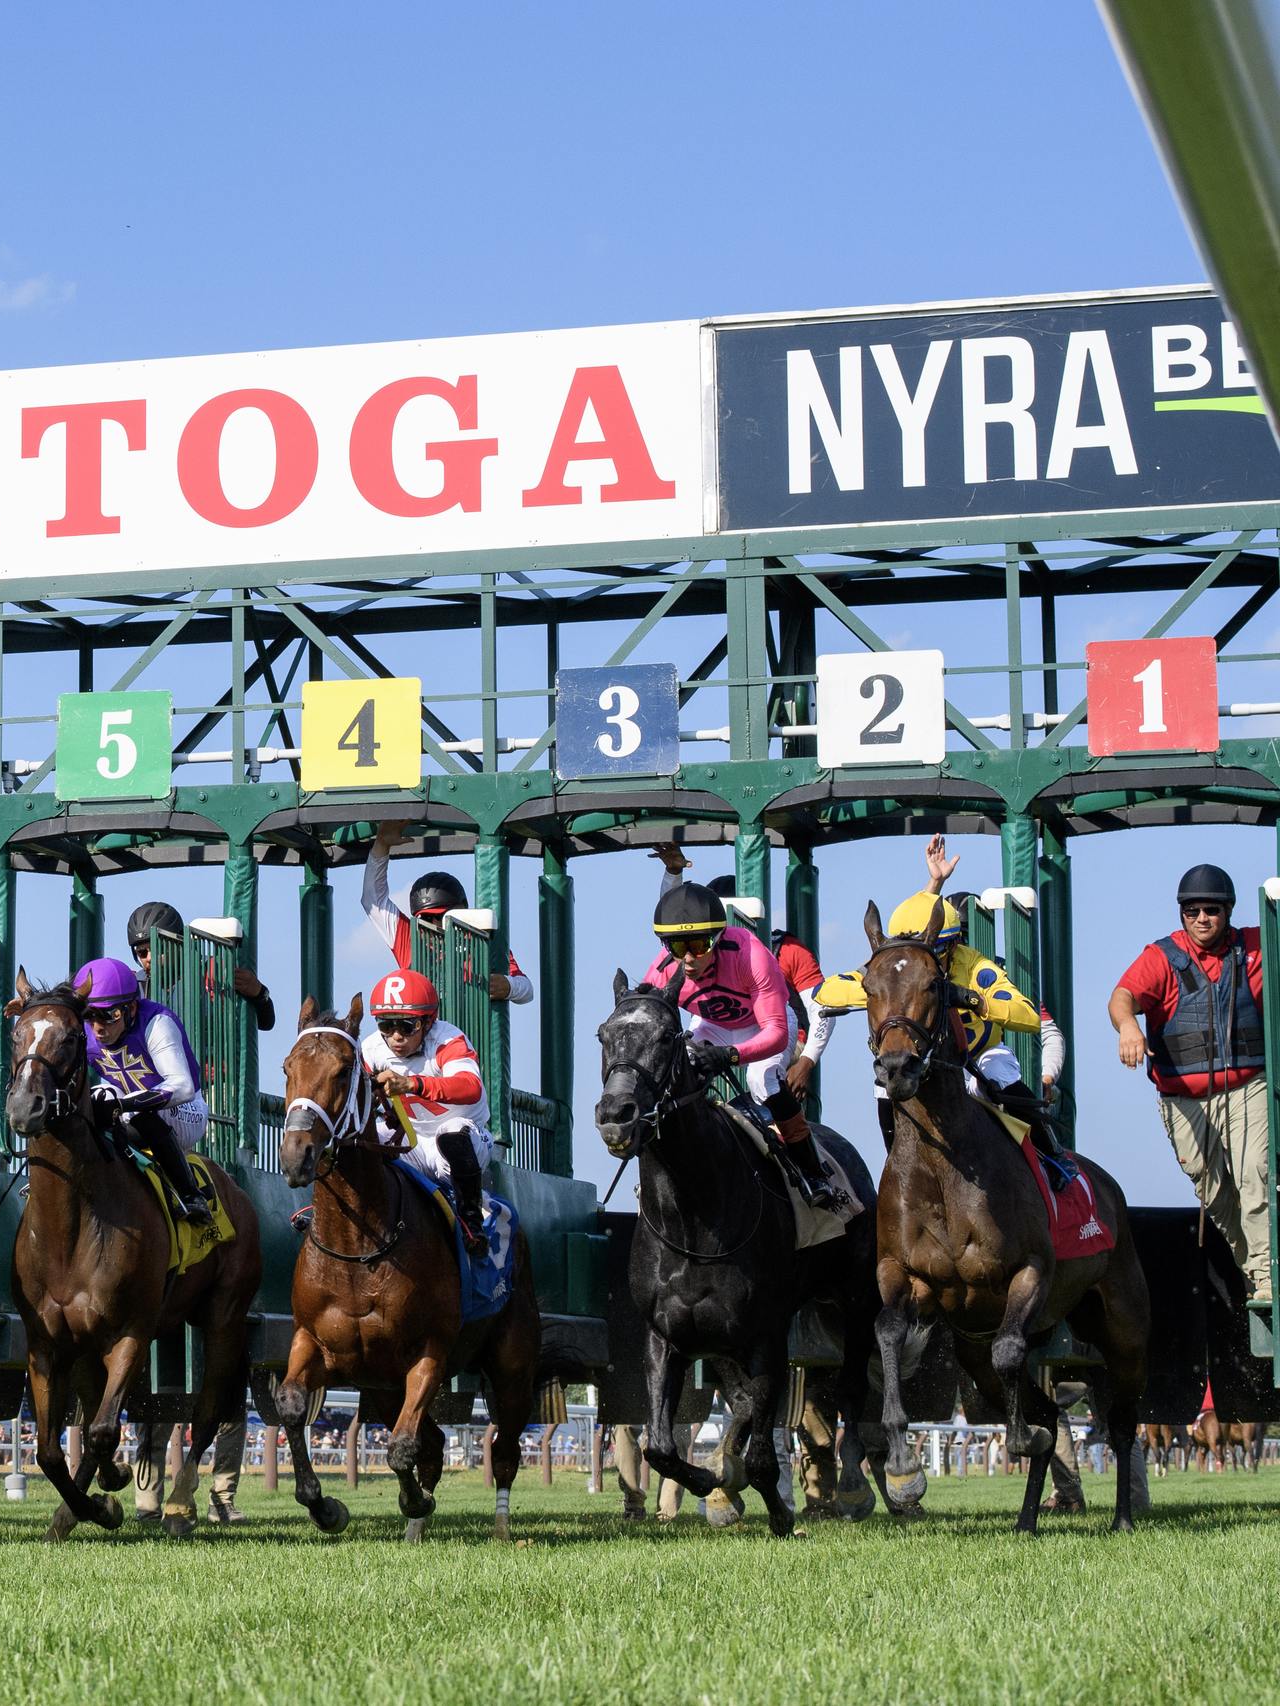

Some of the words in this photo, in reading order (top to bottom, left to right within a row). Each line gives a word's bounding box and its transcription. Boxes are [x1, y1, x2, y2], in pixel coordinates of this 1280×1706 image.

[786, 329, 1139, 495] NYRA
[598, 685, 640, 758] 3
[859, 673, 905, 745] 2
[1132, 658, 1168, 734] 1
[96, 709, 138, 780] 5
[337, 698, 382, 768] 4
[383, 976, 406, 1005] R
